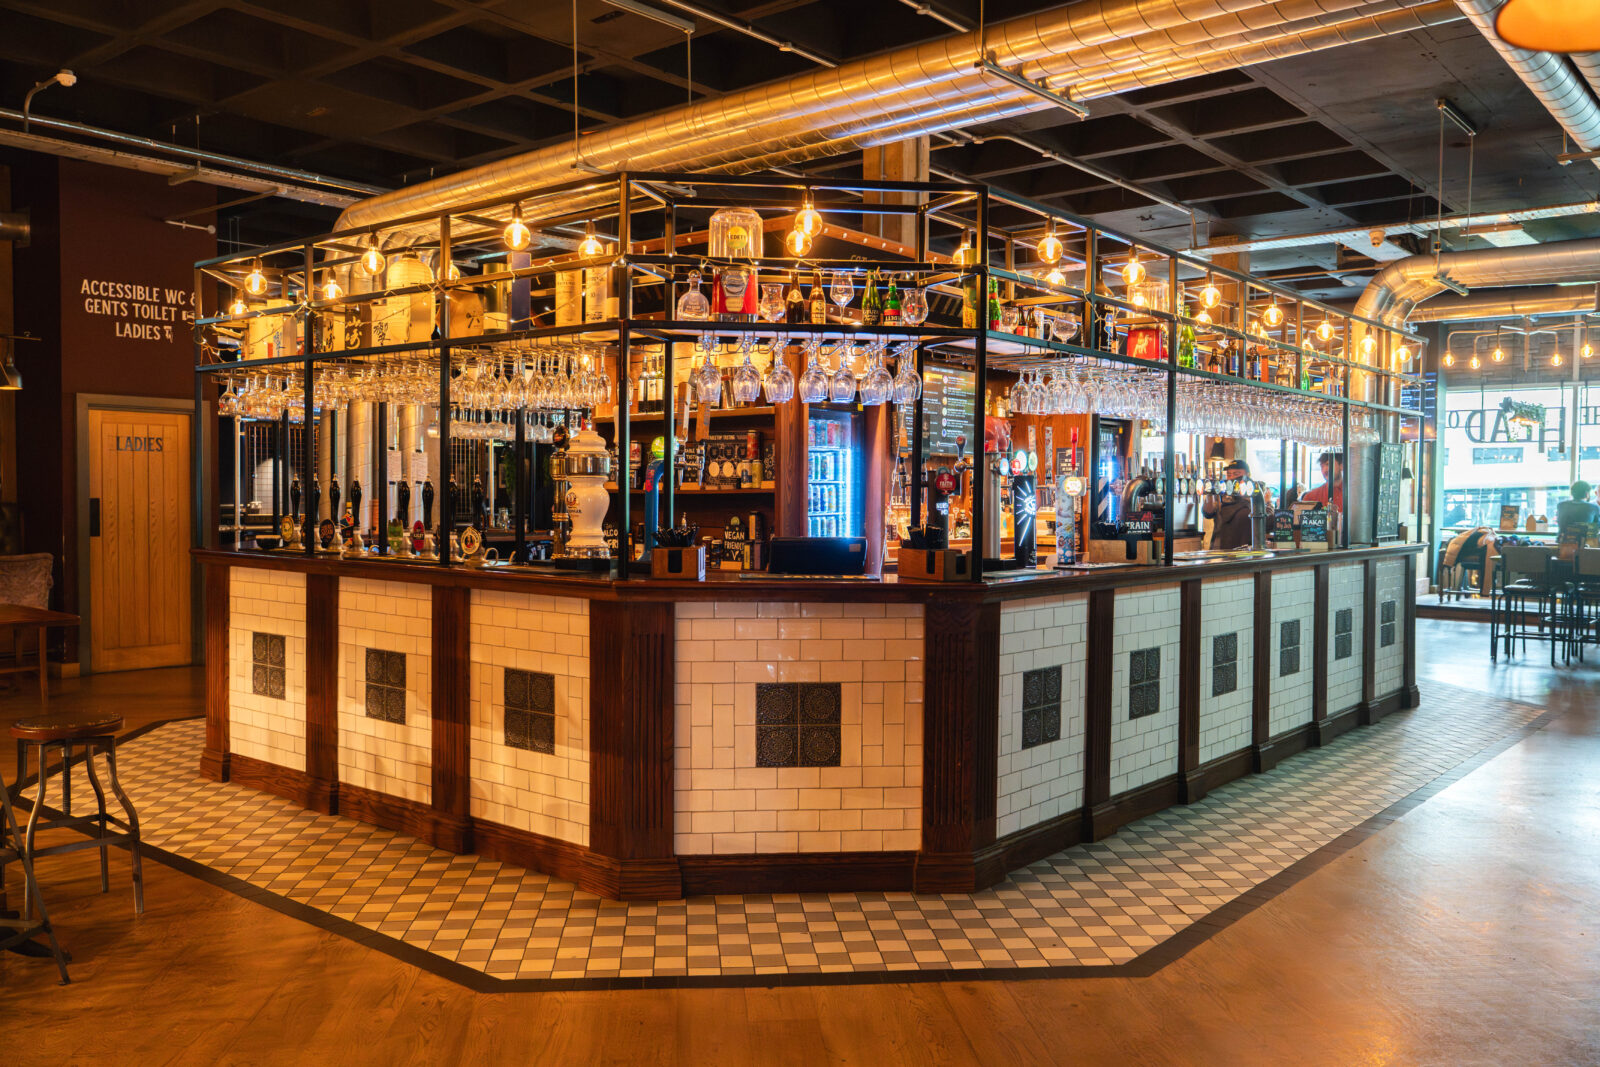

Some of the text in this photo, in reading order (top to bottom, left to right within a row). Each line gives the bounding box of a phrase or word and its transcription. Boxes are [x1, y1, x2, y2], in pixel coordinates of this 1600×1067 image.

[81, 279, 160, 302] ACCESSIBLE
[165, 289, 186, 306] WC
[85, 298, 177, 322] GENTS TOILET
[115, 322, 161, 341] LADIES
[116, 436, 163, 452] LADIES
[724, 531, 745, 540] VEGAN
